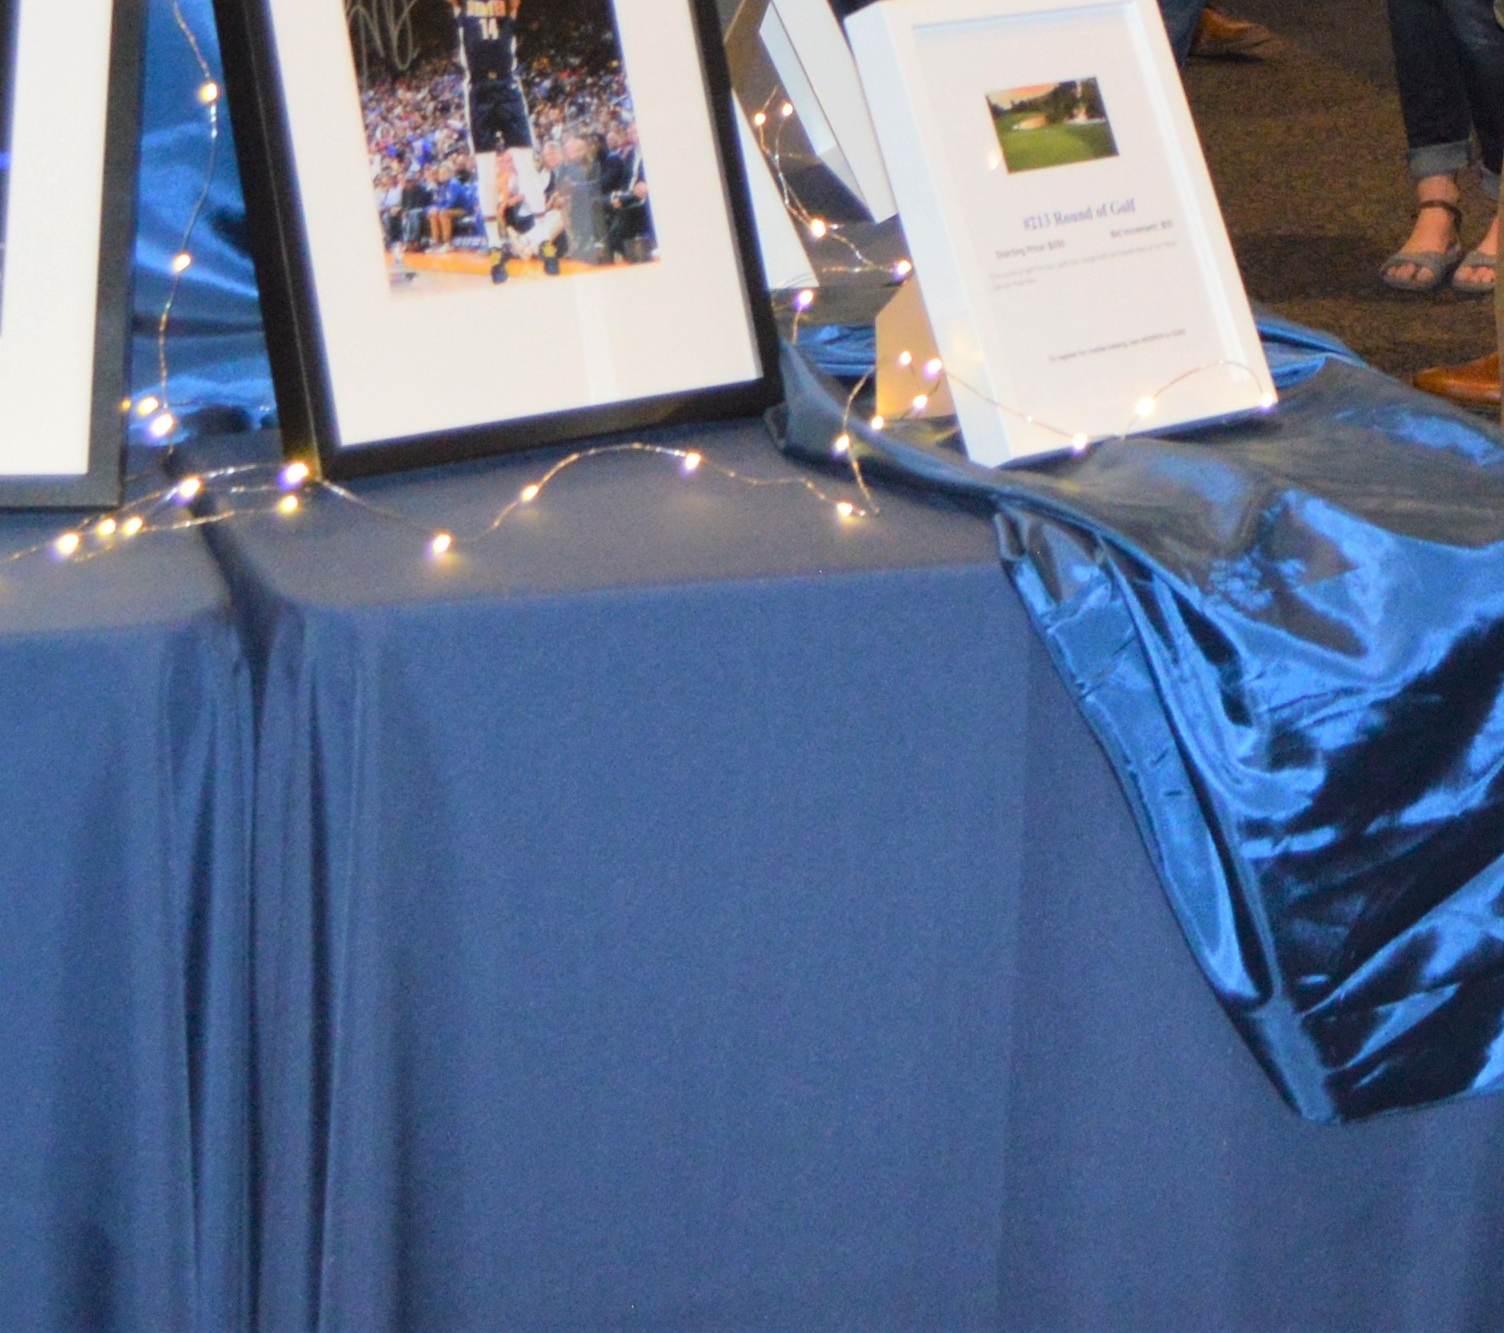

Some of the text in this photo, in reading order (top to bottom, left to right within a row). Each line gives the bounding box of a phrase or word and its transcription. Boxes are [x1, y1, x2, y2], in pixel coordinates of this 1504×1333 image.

[1053, 207, 1094, 226] Round
[1095, 203, 1108, 218] of
[1110, 198, 1136, 214] Golf
